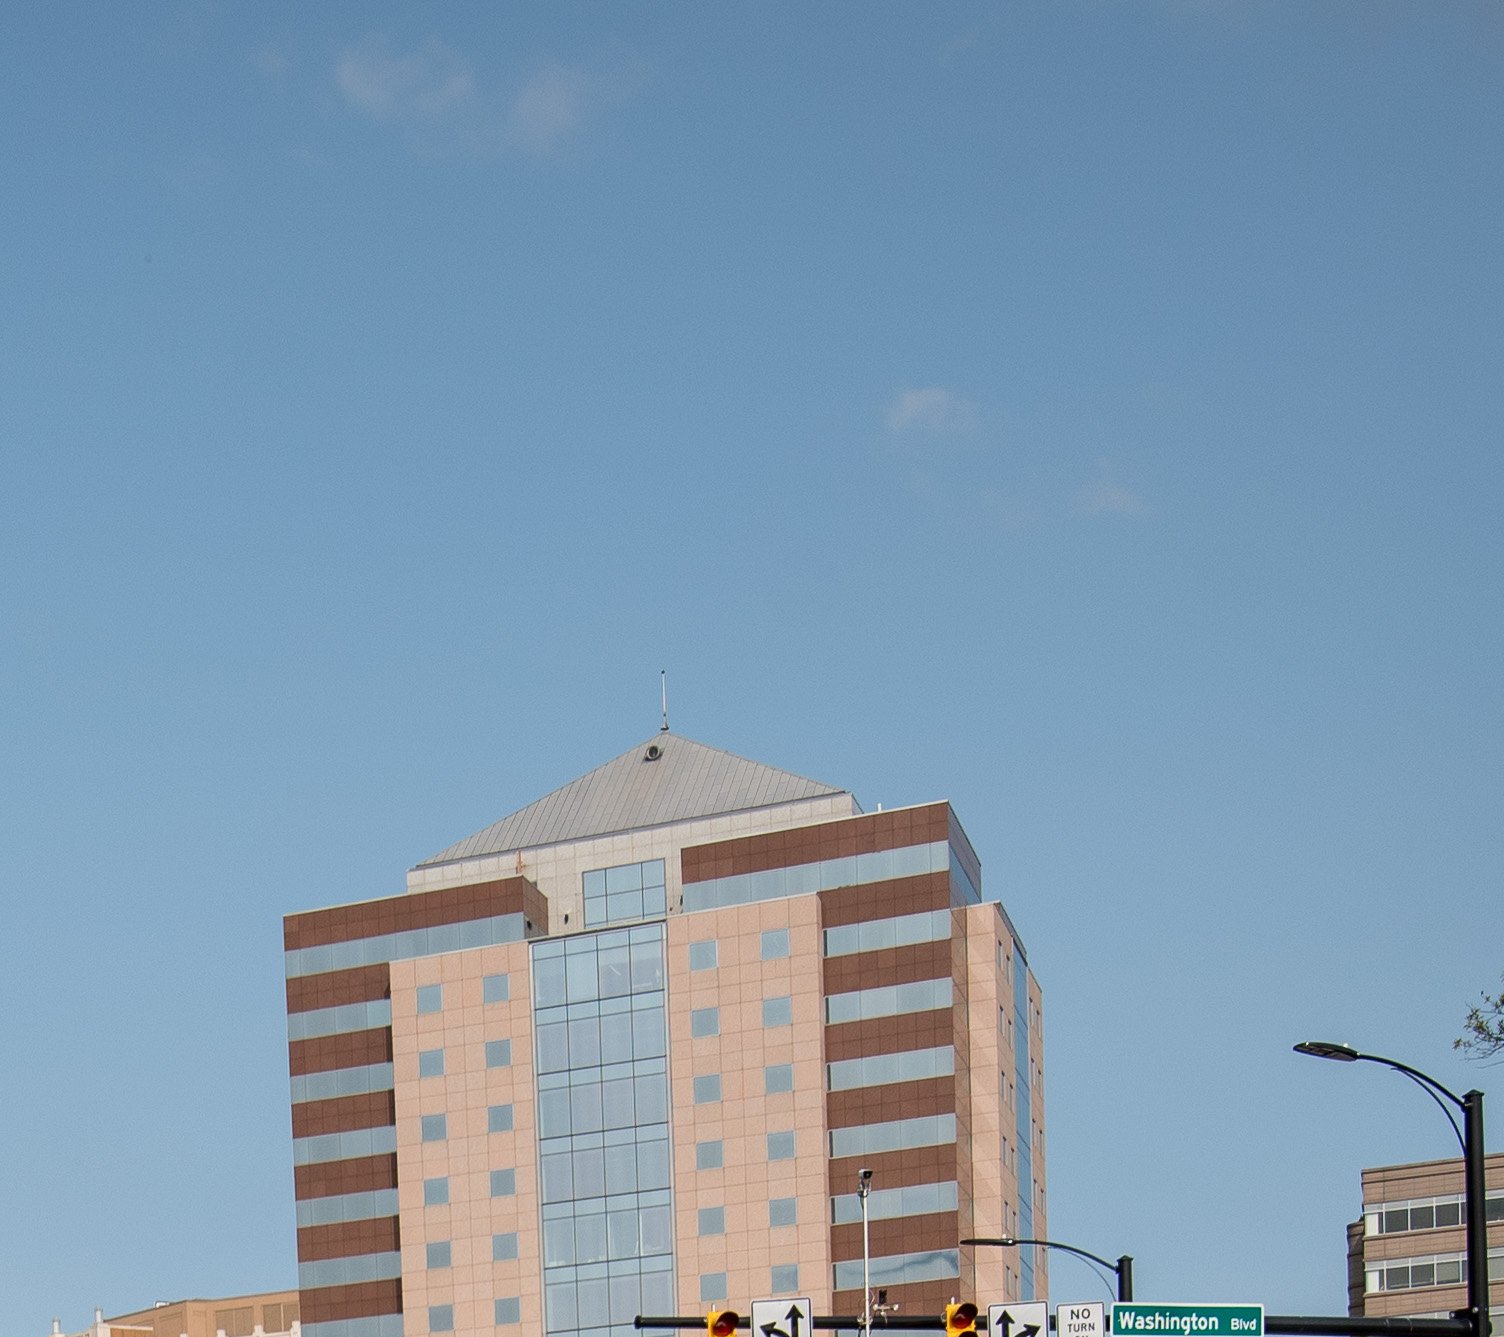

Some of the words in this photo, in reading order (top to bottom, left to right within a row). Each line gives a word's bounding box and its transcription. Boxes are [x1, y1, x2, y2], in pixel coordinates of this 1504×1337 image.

[1070, 1309, 1091, 1320] NO
[1067, 1323, 1096, 1333] TURN
[1118, 1311, 1219, 1335] Washington
[1230, 1317, 1257, 1331] Blvd
